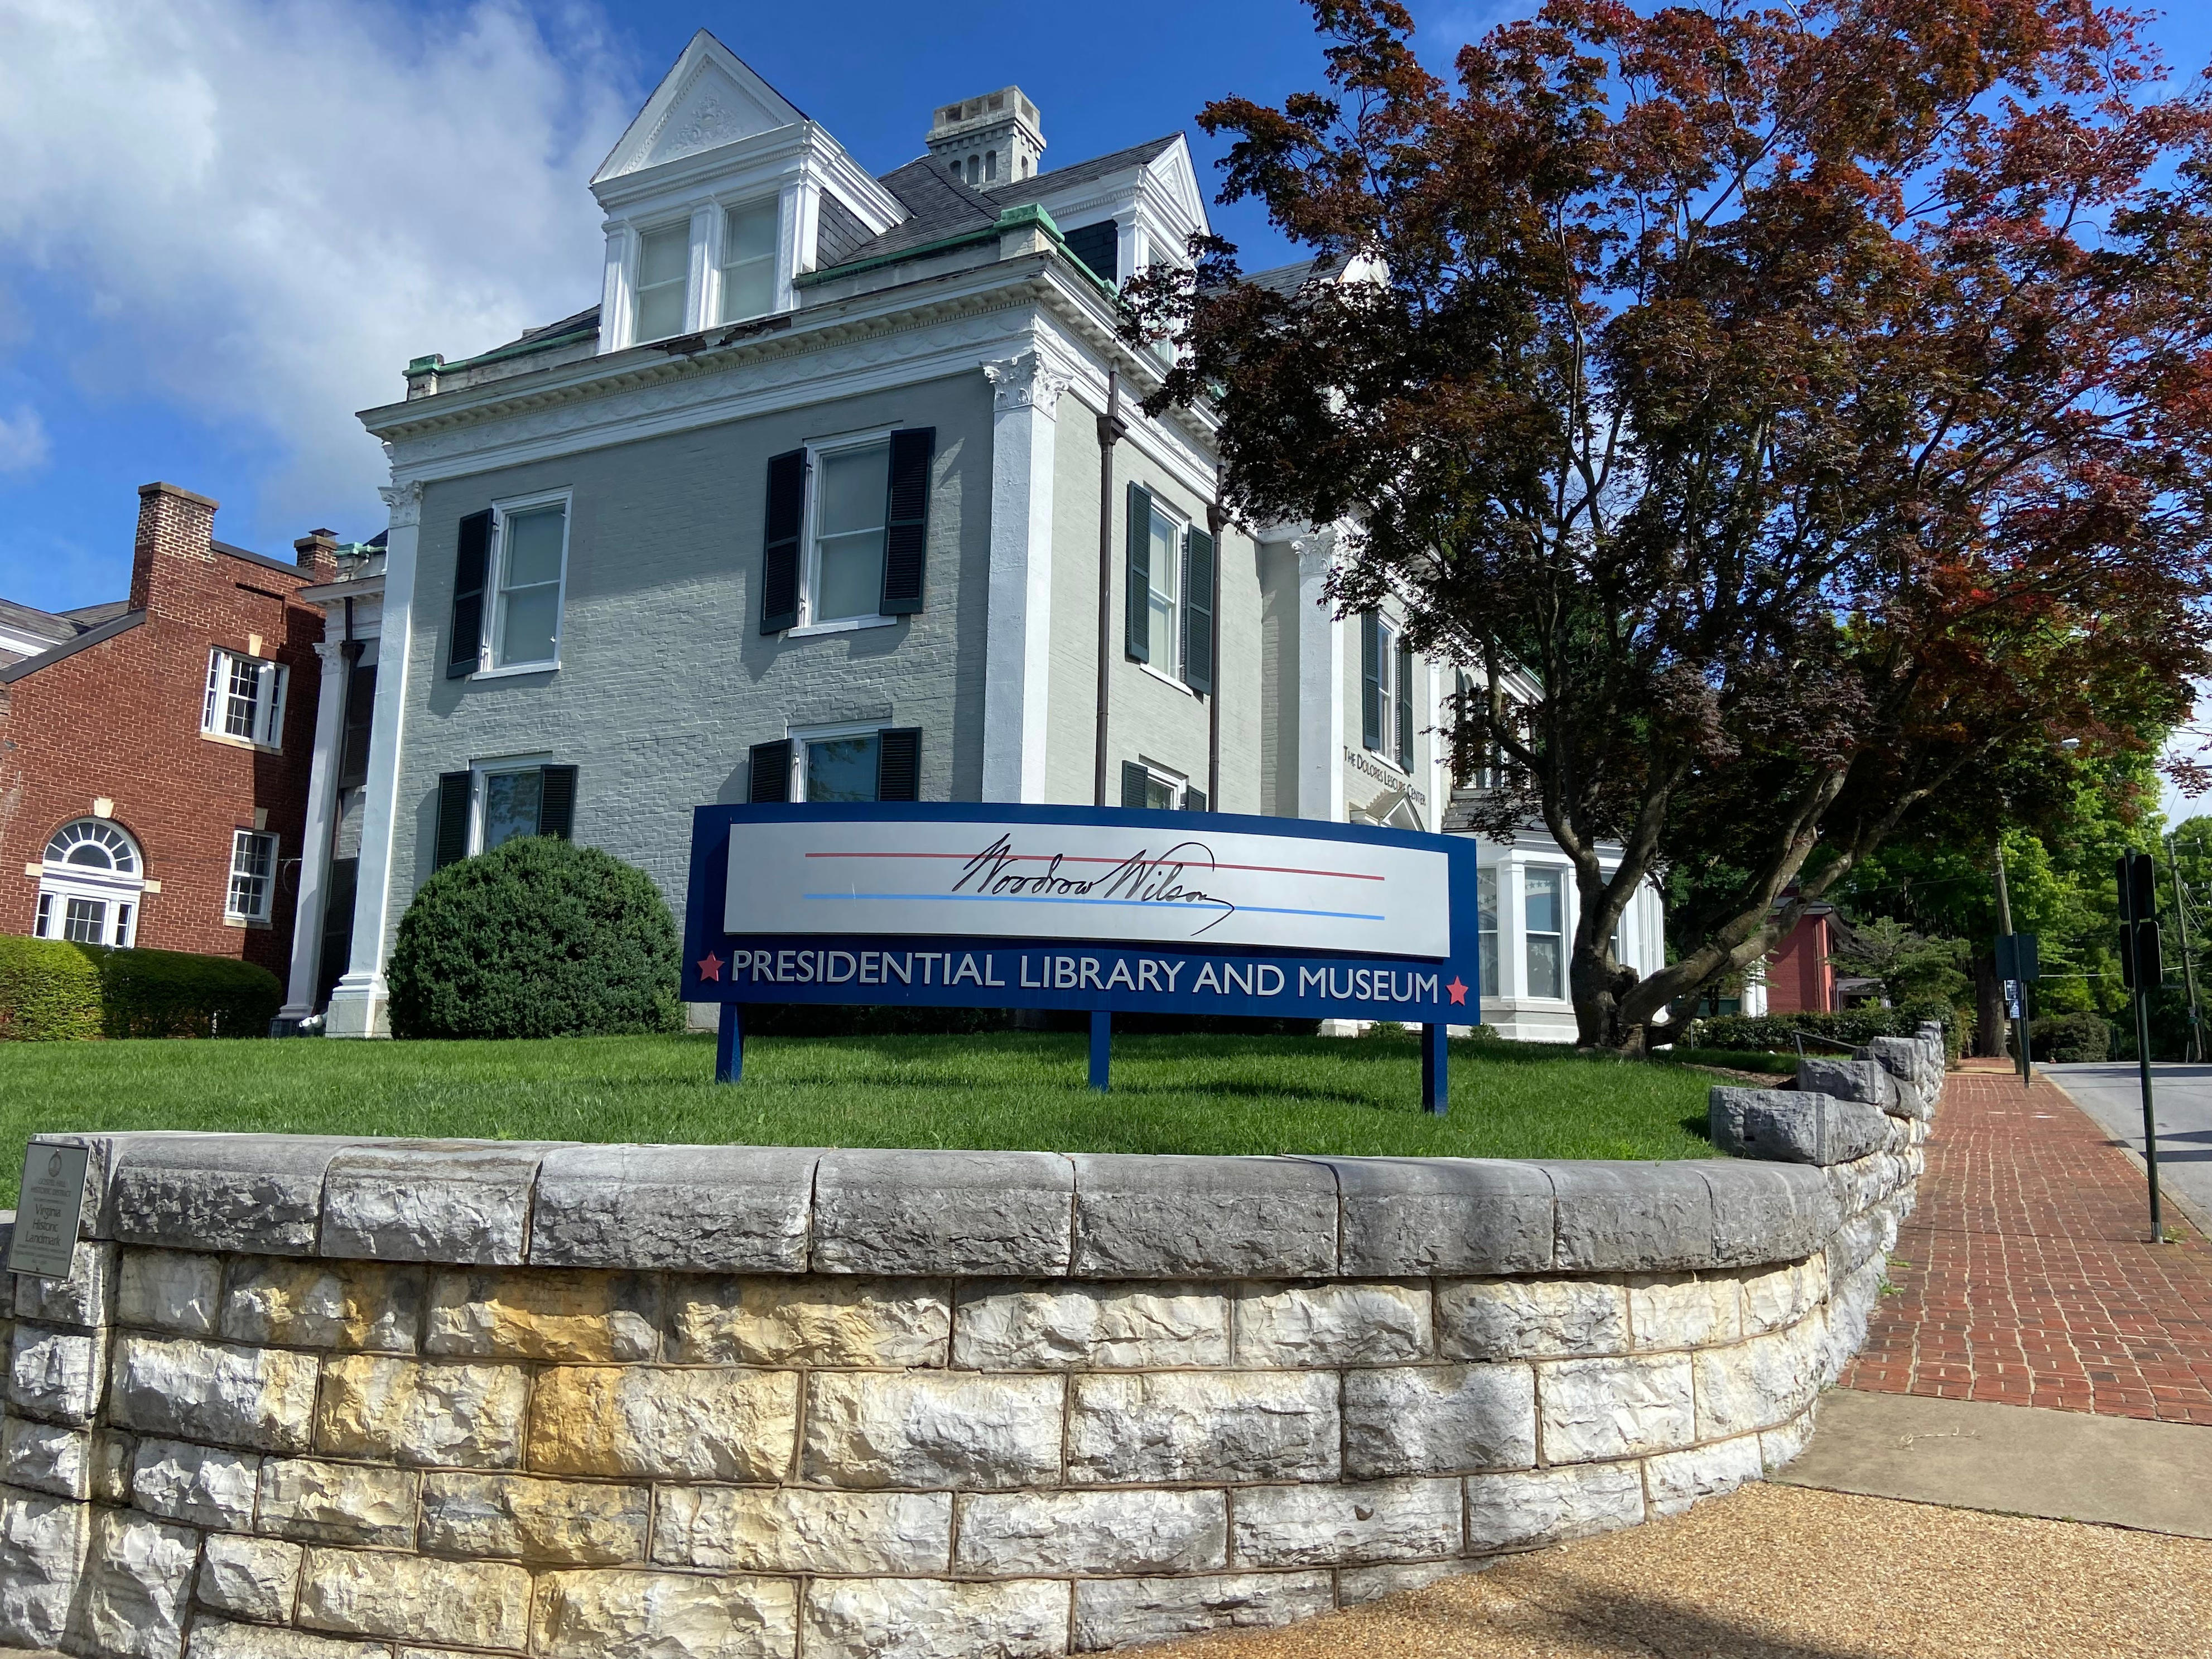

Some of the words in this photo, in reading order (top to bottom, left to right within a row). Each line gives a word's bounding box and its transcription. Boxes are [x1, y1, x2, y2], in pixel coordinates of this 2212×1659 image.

[952, 833, 1096, 895] Woodrow
[1103, 842, 1235, 937] Wilson
[731, 950, 1005, 986] PRESIDENTIAL
[1020, 954, 1185, 992] LIBRARY
[1192, 962, 1285, 996] AND
[1299, 966, 1438, 1004] MUSEUM
[36, 1203, 61, 1220] Virginia
[32, 1219, 59, 1232] Historic
[25, 1231, 61, 1247] Landmark
